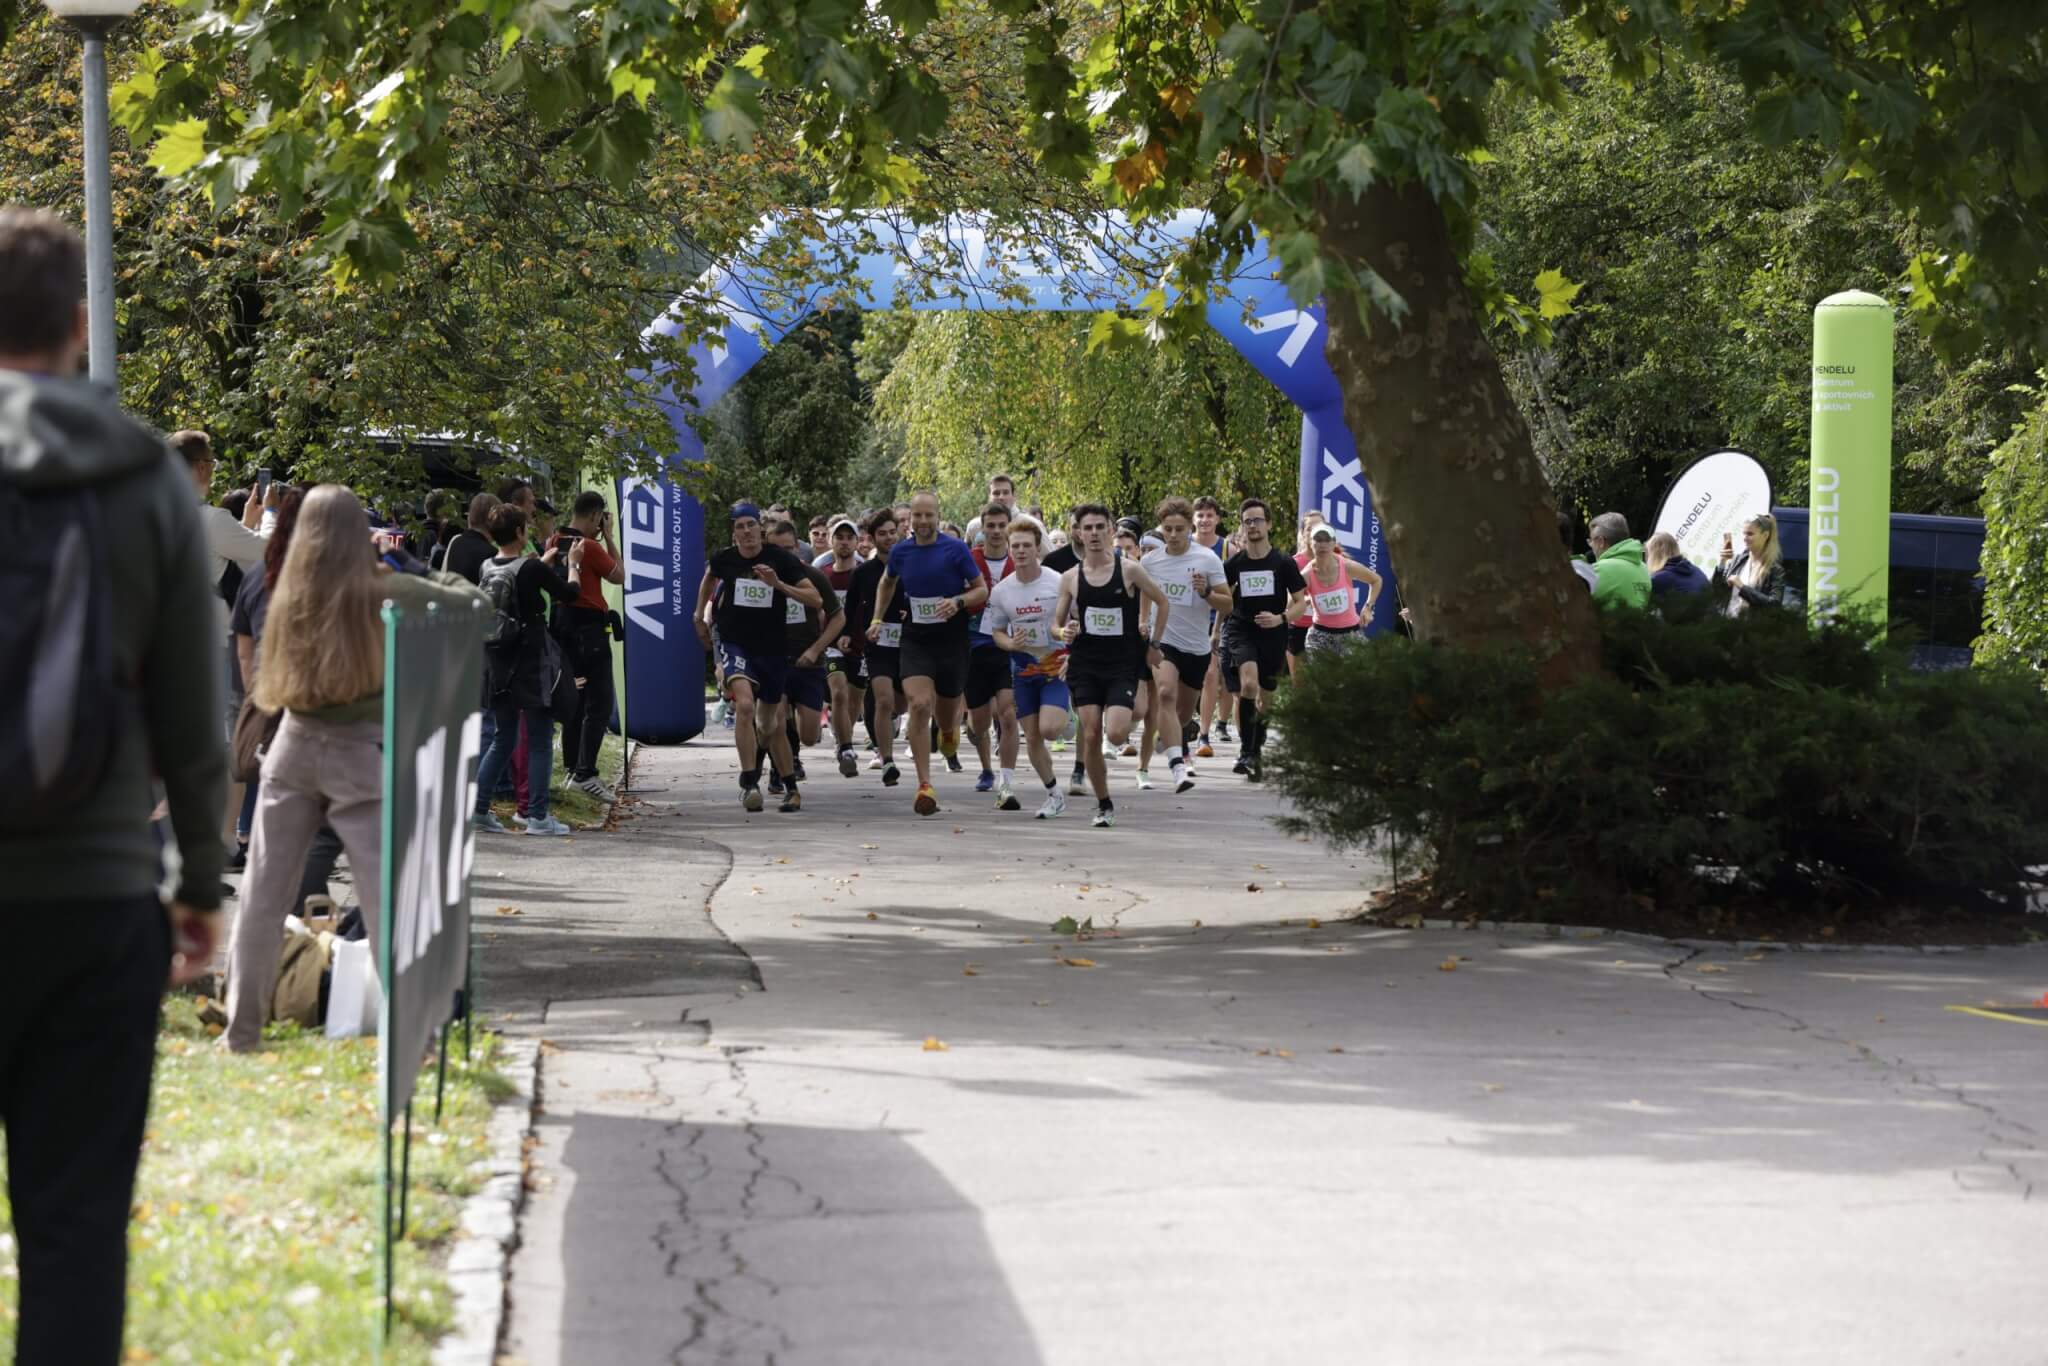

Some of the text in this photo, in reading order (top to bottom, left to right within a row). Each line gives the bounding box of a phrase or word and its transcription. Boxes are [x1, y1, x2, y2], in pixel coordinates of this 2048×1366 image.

[672, 507, 682, 533] OUT.
[1814, 466, 1841, 628] ENDELU
[672, 537, 682, 573] WORK
[1245, 576, 1268, 589] 139
[742, 586, 767, 599] 183
[1163, 583, 1187, 596] 107
[672, 577, 682, 616] WEAR.
[1322, 595, 1342, 608] 141
[1091, 614, 1116, 627] 152
